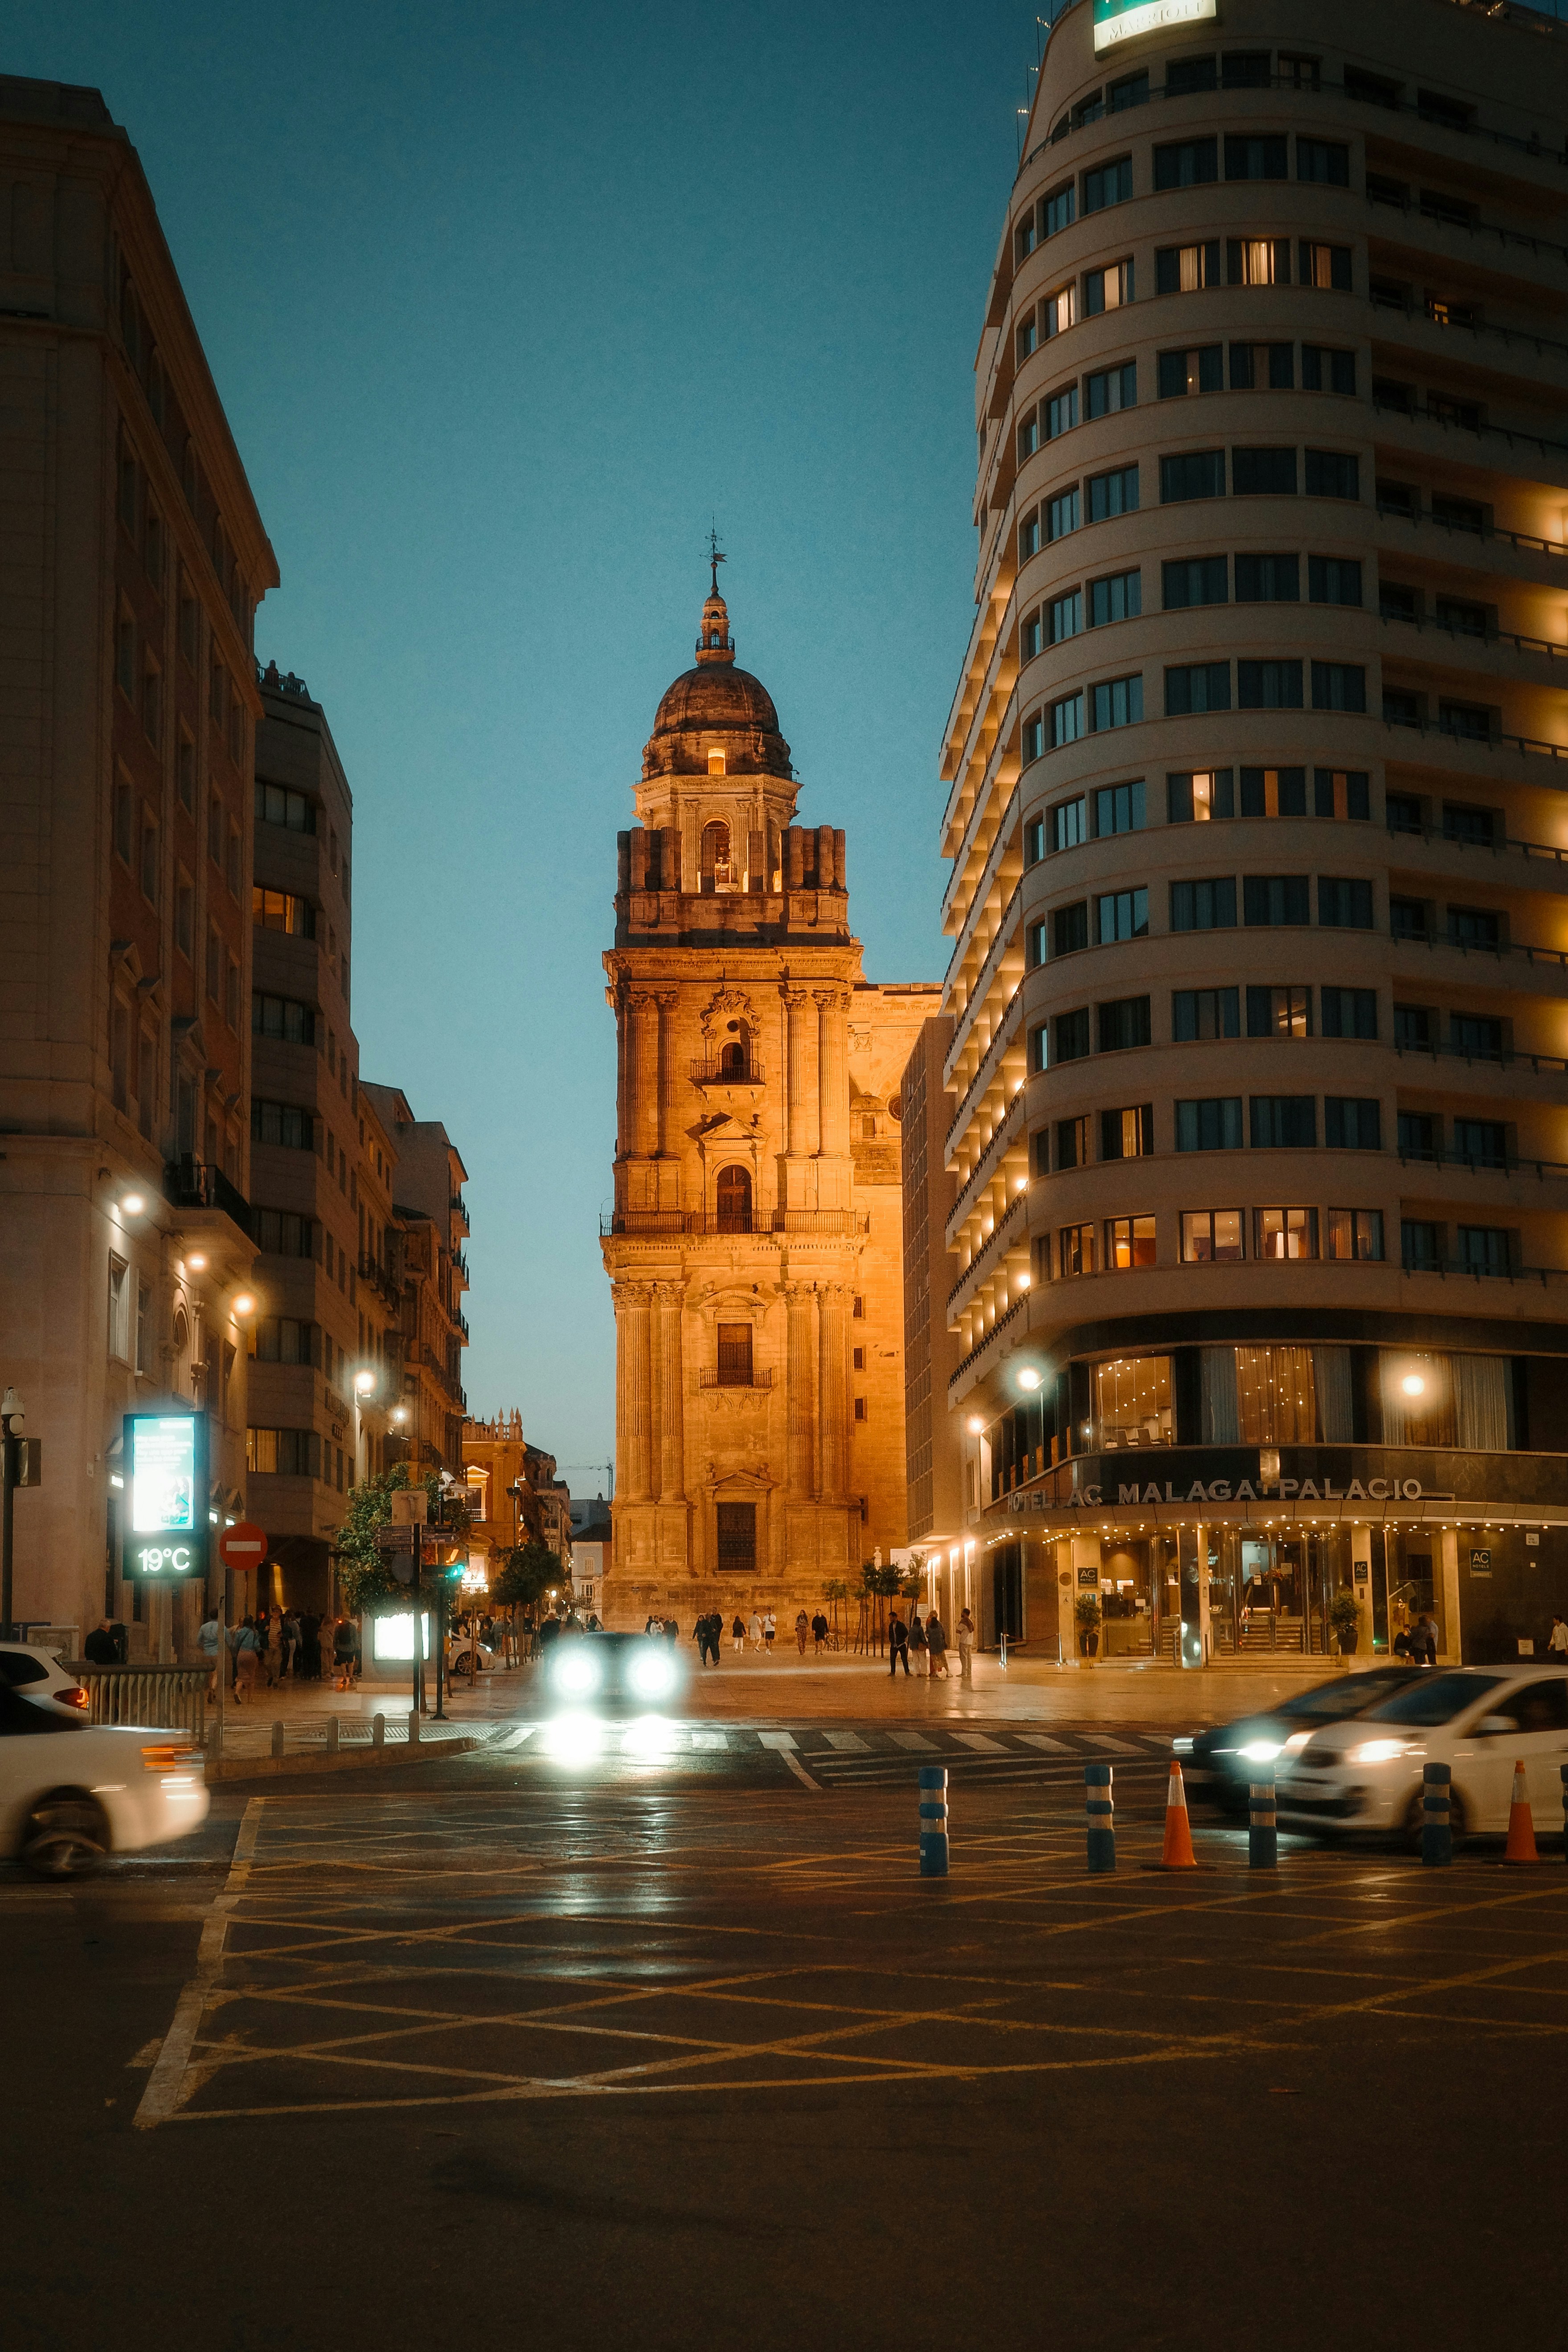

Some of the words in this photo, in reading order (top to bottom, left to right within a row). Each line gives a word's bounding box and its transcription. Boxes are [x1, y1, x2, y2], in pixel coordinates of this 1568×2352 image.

[1109, 1, 1204, 41] MARRIOTT
[1007, 1489, 1053, 1513] HOTEL
[1067, 1485, 1103, 1507] AC
[1118, 1480, 1258, 1504] MALAGA
[1278, 1478, 1422, 1500] PALACIO
[138, 1547, 189, 1571] 19°C
[1356, 1564, 1366, 1572] AC
[1473, 1552, 1489, 1563] AC
